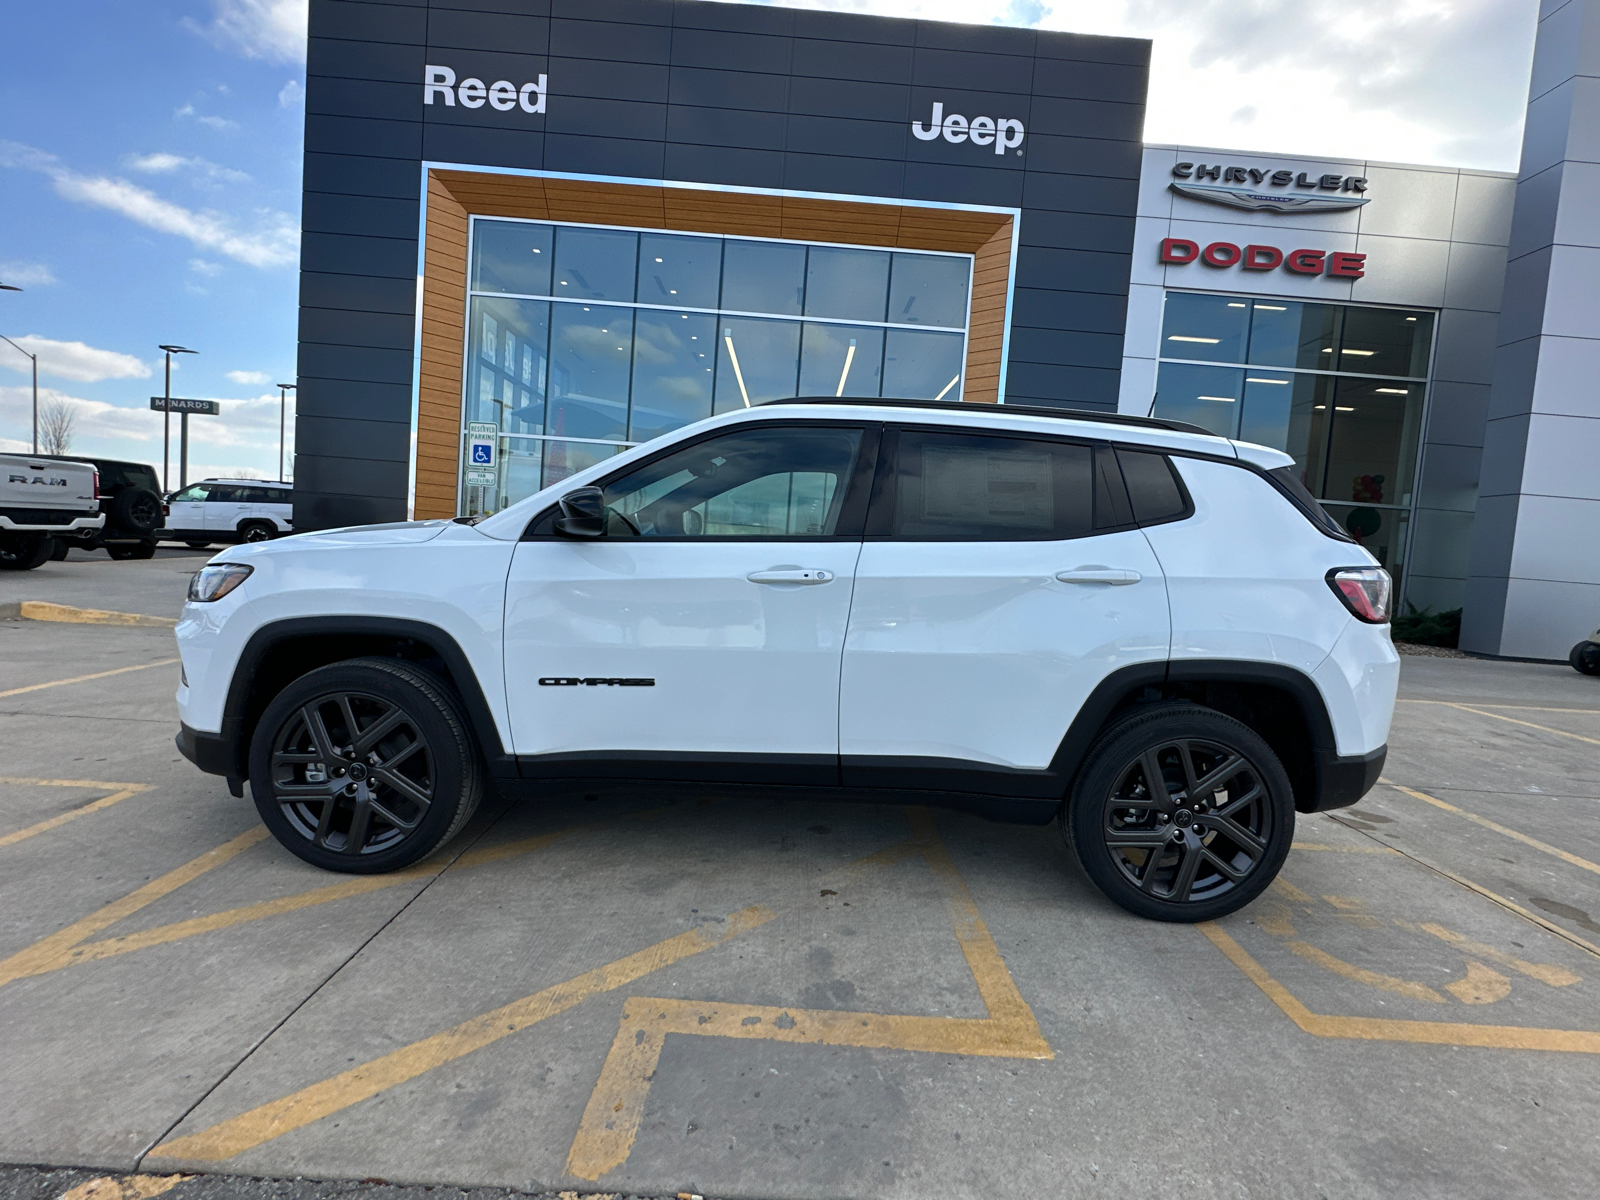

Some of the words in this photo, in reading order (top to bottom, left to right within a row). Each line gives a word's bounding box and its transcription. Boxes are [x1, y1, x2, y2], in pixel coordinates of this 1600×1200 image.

[424, 65, 547, 114] Reed
[912, 102, 1025, 155] Jeep
[1173, 162, 1368, 191] CHRYSLER
[1161, 238, 1367, 278] DODGE
[470, 425, 496, 434] RESERVED
[470, 433, 496, 441] PARKING
[8, 474, 67, 487] RAM
[538, 677, 656, 686] COMPASS
